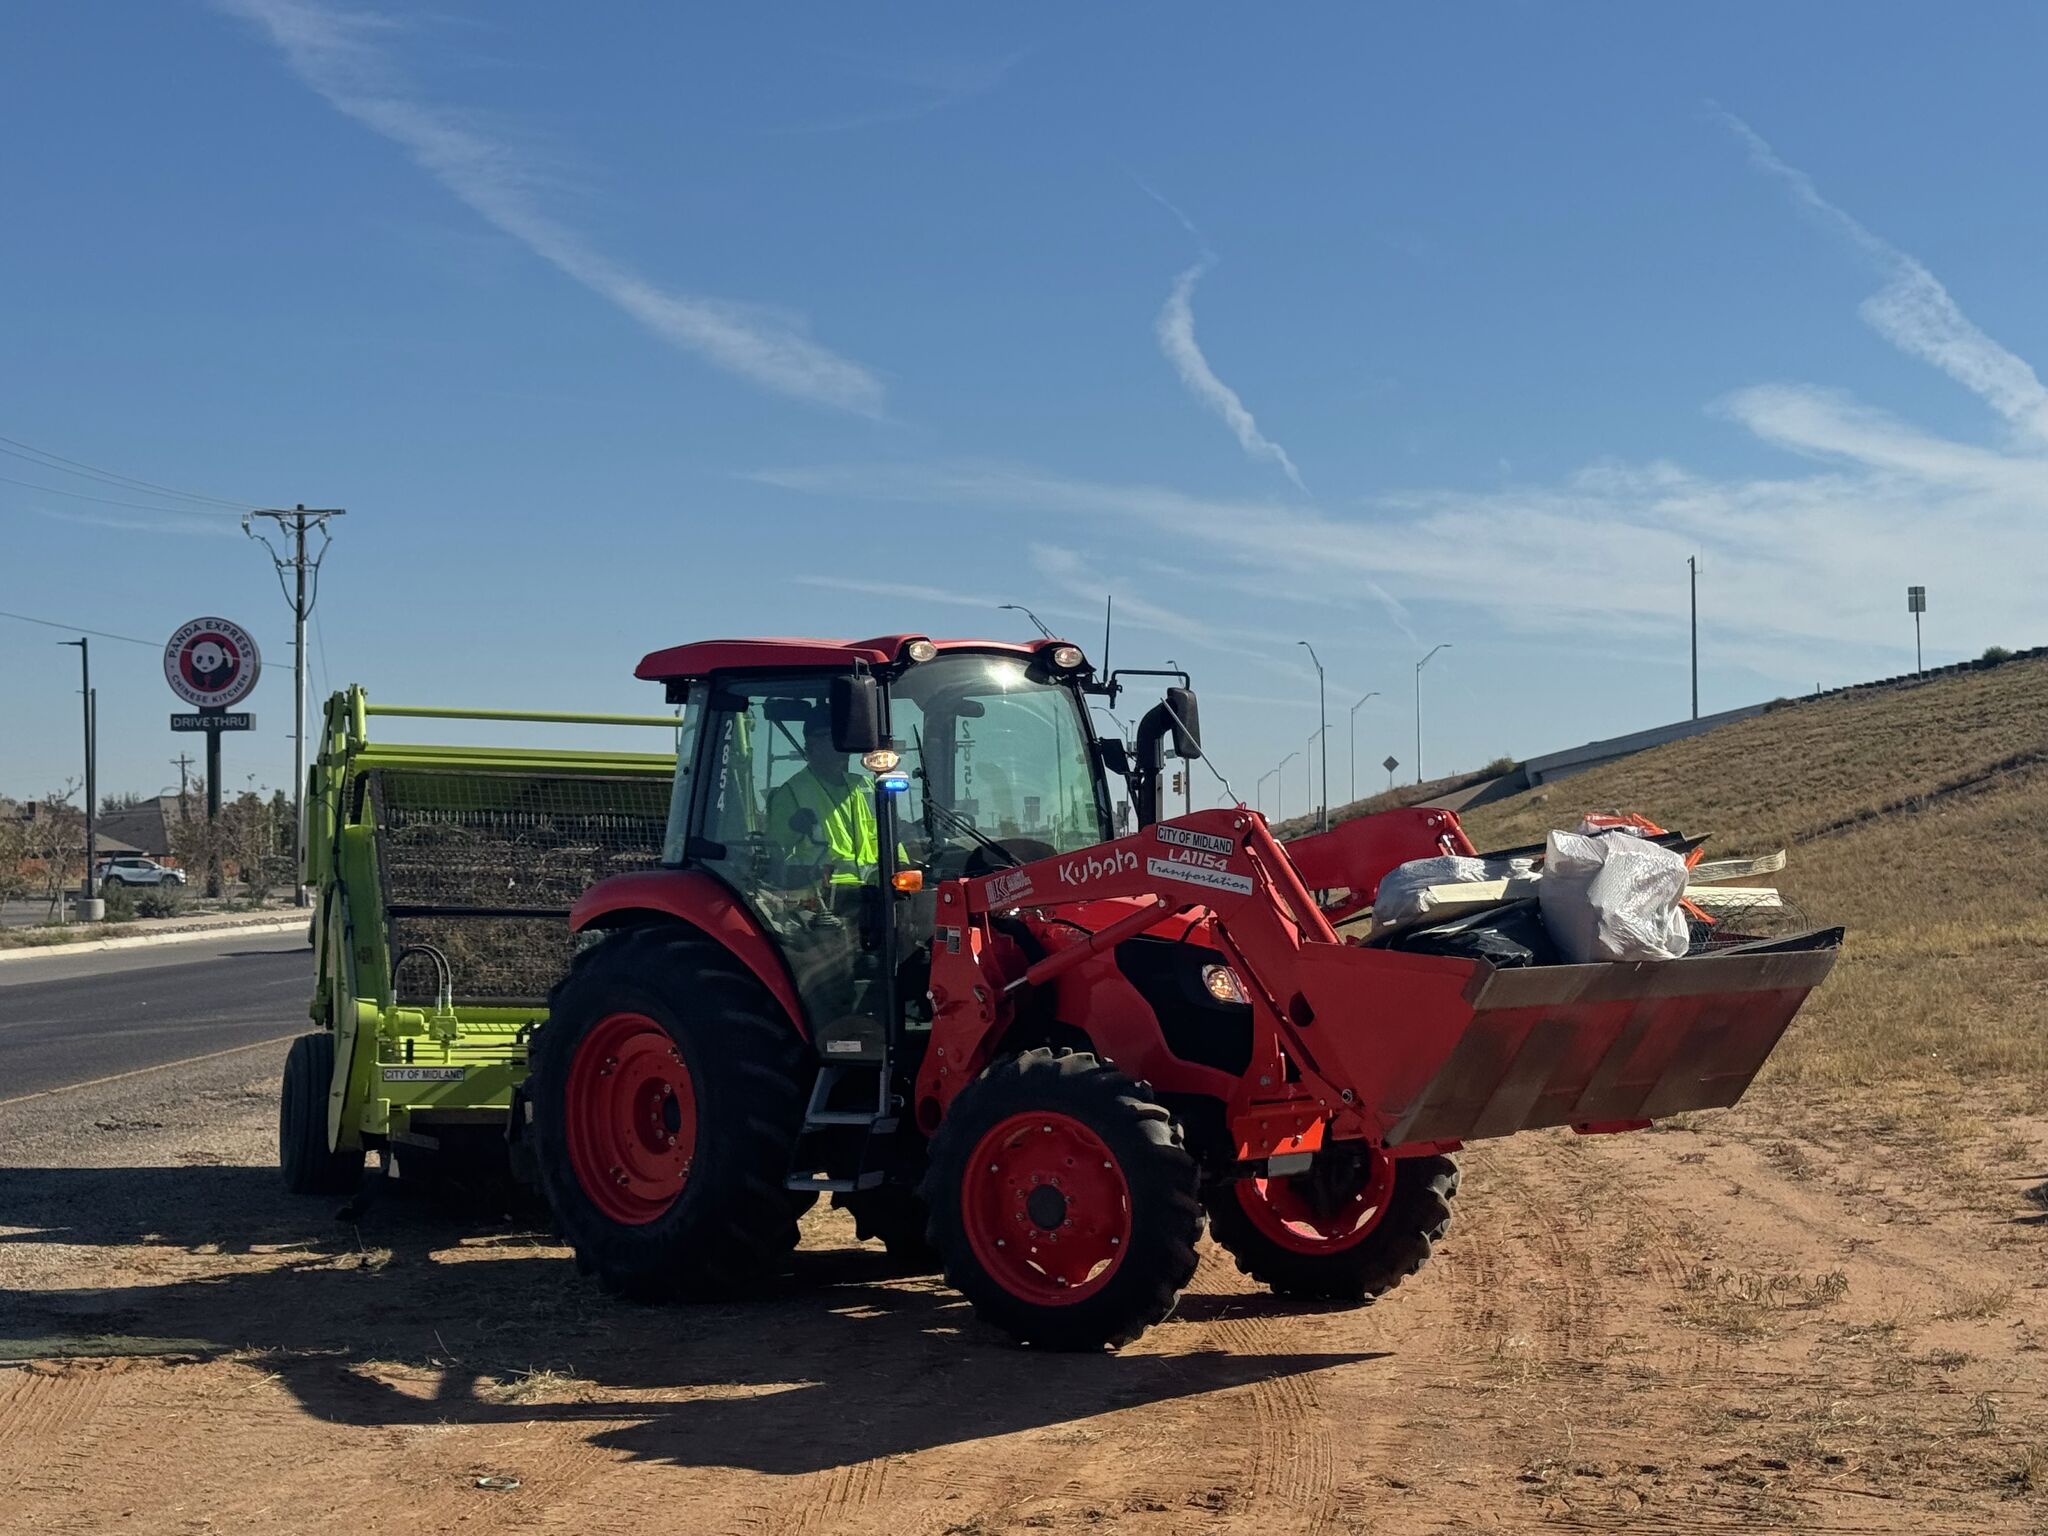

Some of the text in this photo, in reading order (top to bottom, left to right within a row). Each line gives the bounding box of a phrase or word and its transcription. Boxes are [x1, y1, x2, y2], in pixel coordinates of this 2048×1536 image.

[168, 620, 251, 658] PANDA EXPRESS
[171, 673, 248, 703] CHINESE KITCHEN
[173, 716, 247, 727] DRIVE THRU
[716, 719, 733, 812] 2854
[1157, 827, 1232, 853] CITY OF MIDLAND
[1058, 848, 1139, 886] Kubota
[1148, 859, 1250, 891] Transportation
[1168, 848, 1228, 872] LA1154
[384, 1069, 463, 1079] CITY OF MIDLAND
